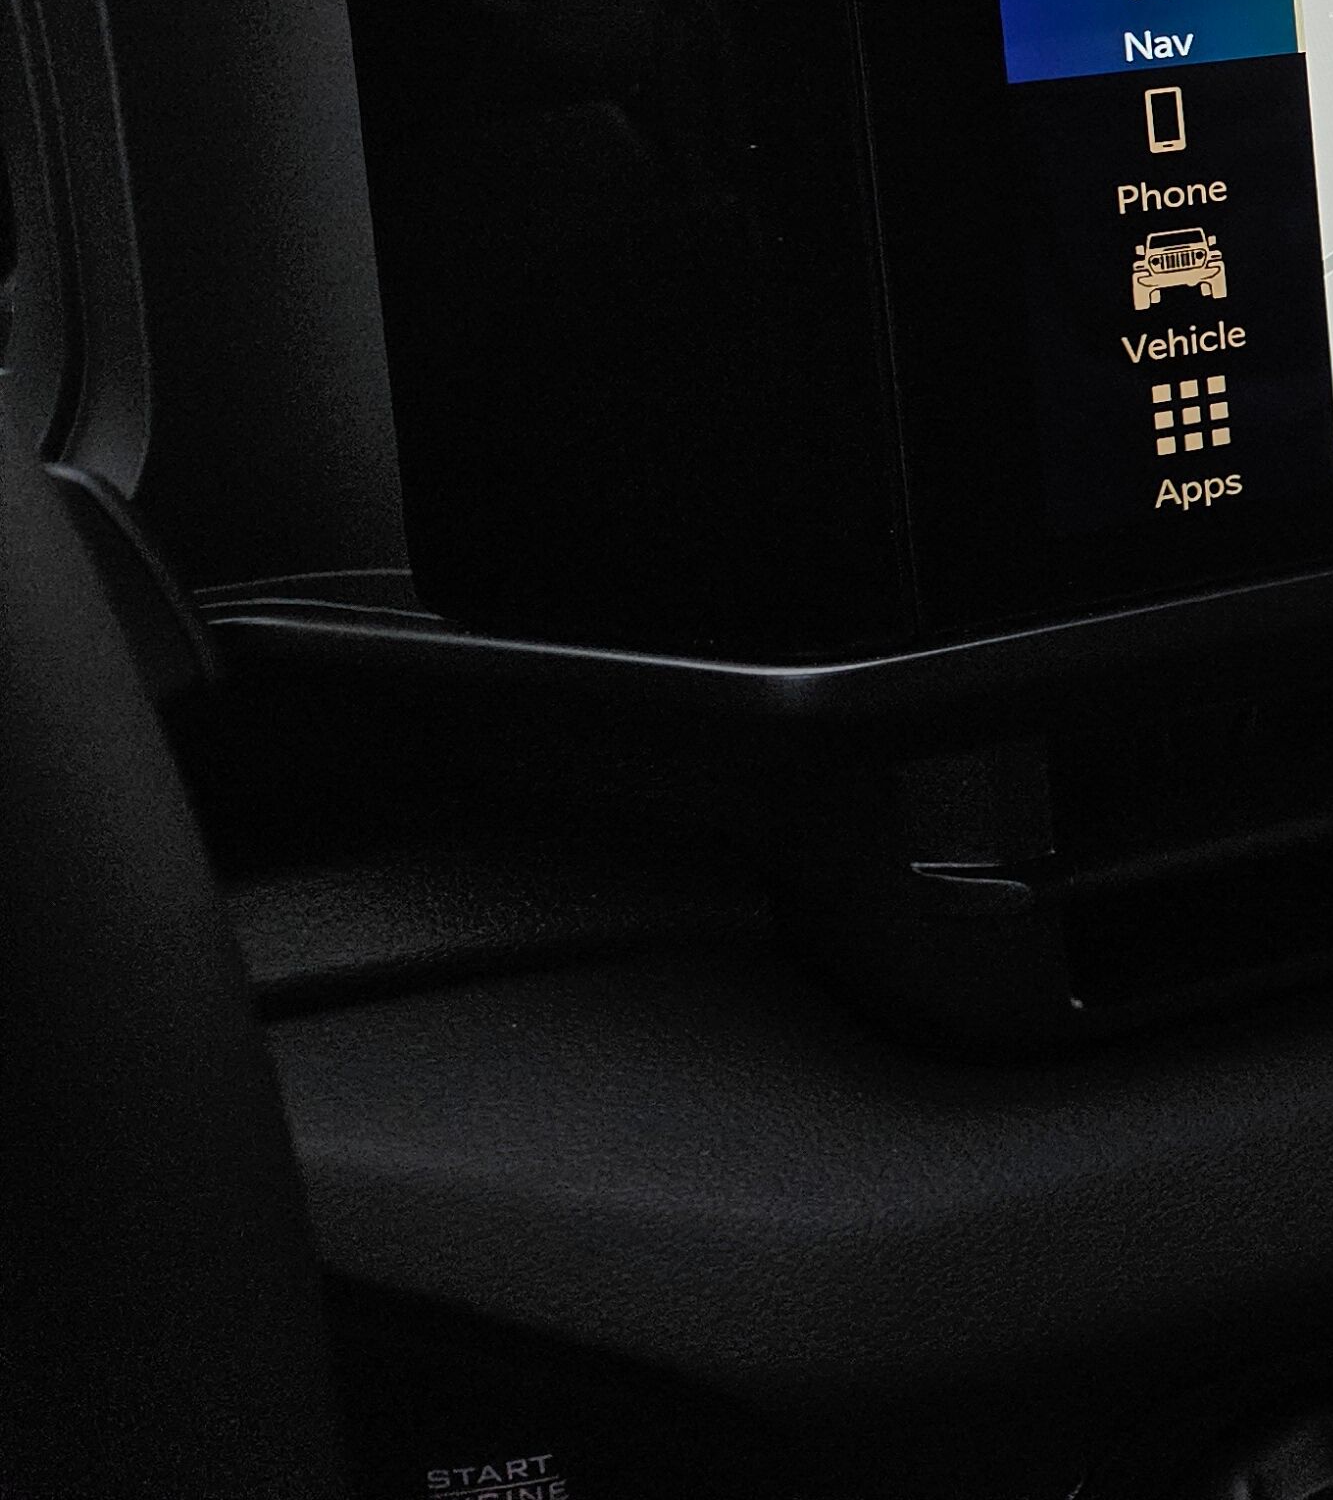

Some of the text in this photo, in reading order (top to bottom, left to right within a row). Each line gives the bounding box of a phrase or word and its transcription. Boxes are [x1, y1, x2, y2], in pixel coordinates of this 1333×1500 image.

[1123, 30, 1195, 62] Nav
[1116, 180, 1228, 215] Phone
[1121, 320, 1247, 365] Vehicle
[1154, 471, 1243, 511] Apps
[426, 1453, 554, 1490] START
